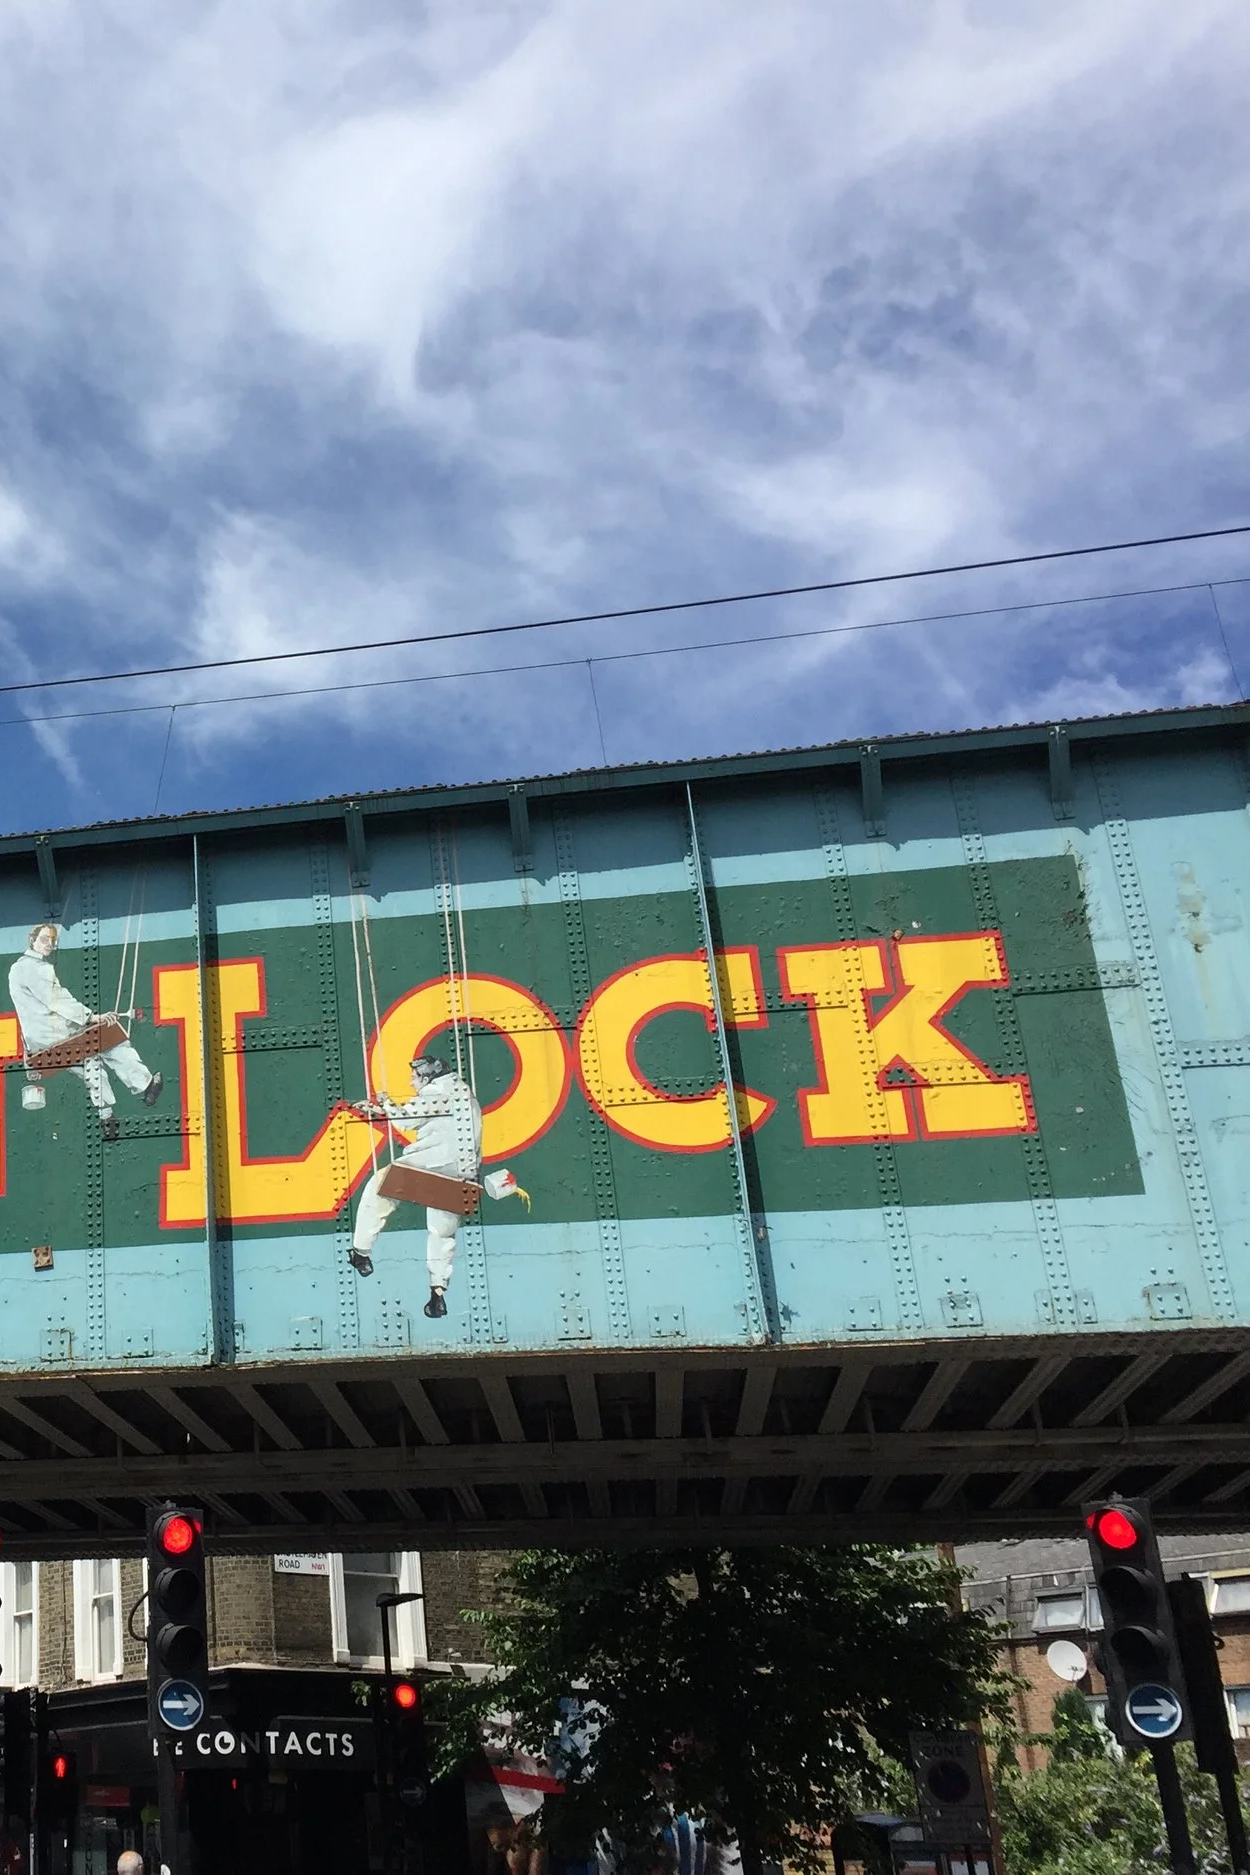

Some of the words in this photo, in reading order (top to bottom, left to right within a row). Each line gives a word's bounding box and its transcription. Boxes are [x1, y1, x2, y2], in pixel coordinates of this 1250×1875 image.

[154, 929, 1038, 1230] LOCK
[278, 1559, 300, 1569] ROAD
[196, 1730, 355, 1757] CONTACTS
